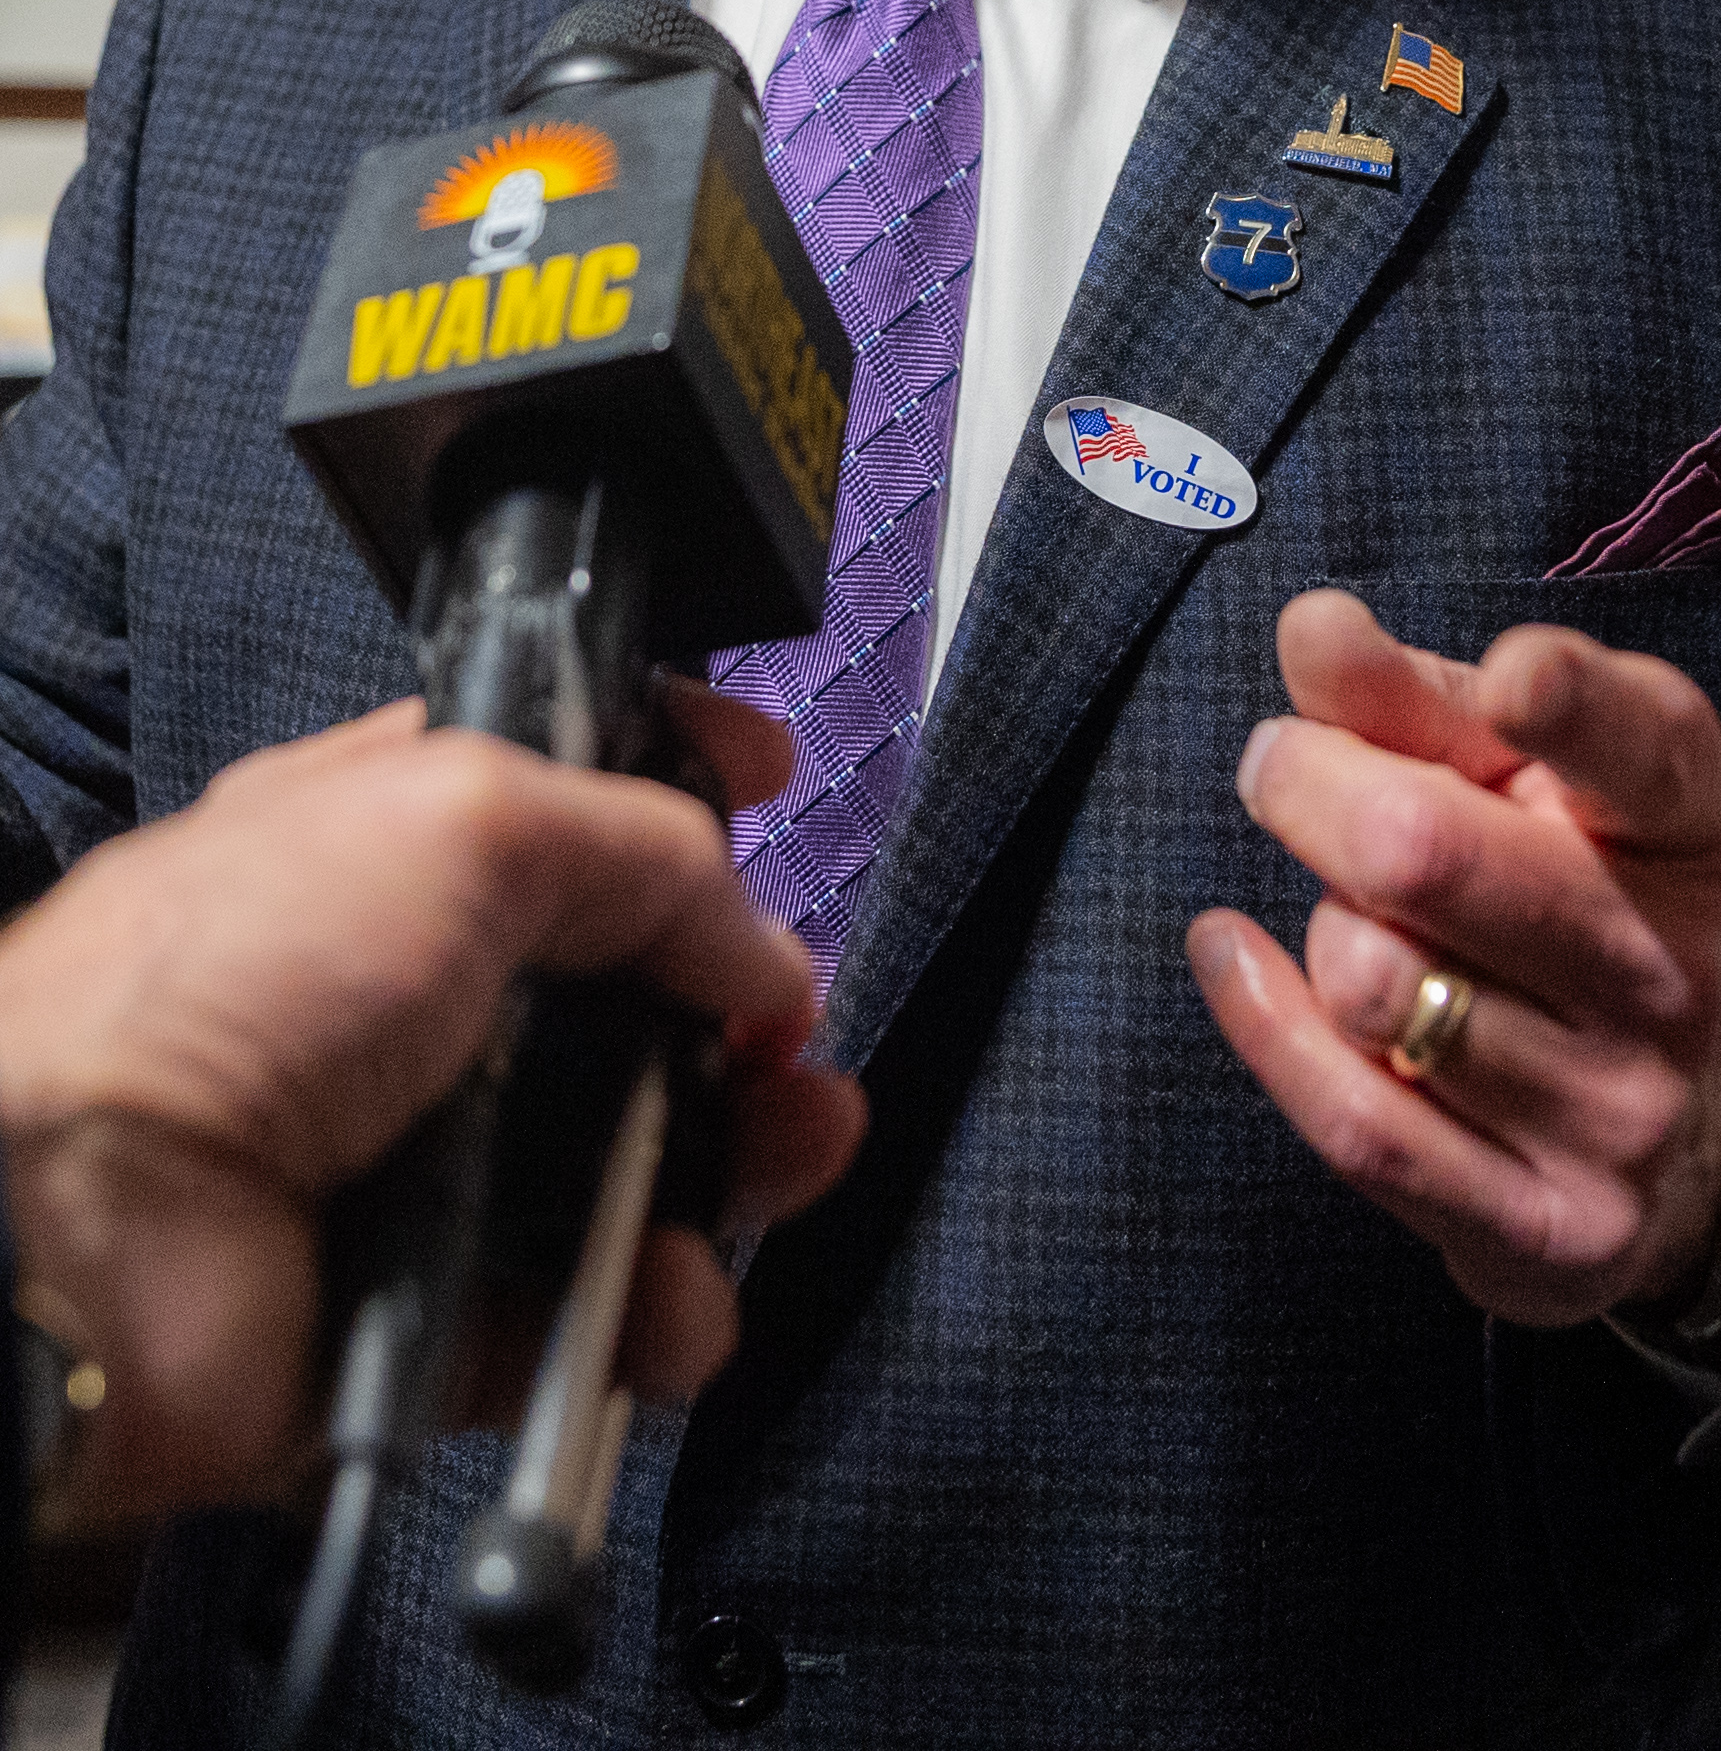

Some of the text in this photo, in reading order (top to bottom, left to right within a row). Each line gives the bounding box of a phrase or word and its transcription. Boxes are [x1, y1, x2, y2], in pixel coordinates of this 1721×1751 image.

[1369, 161, 1388, 177] MA
[1238, 218, 1273, 266] 7
[347, 241, 641, 389] WAMC
[1132, 458, 1237, 520] VOTED
[1183, 453, 1203, 477] I
